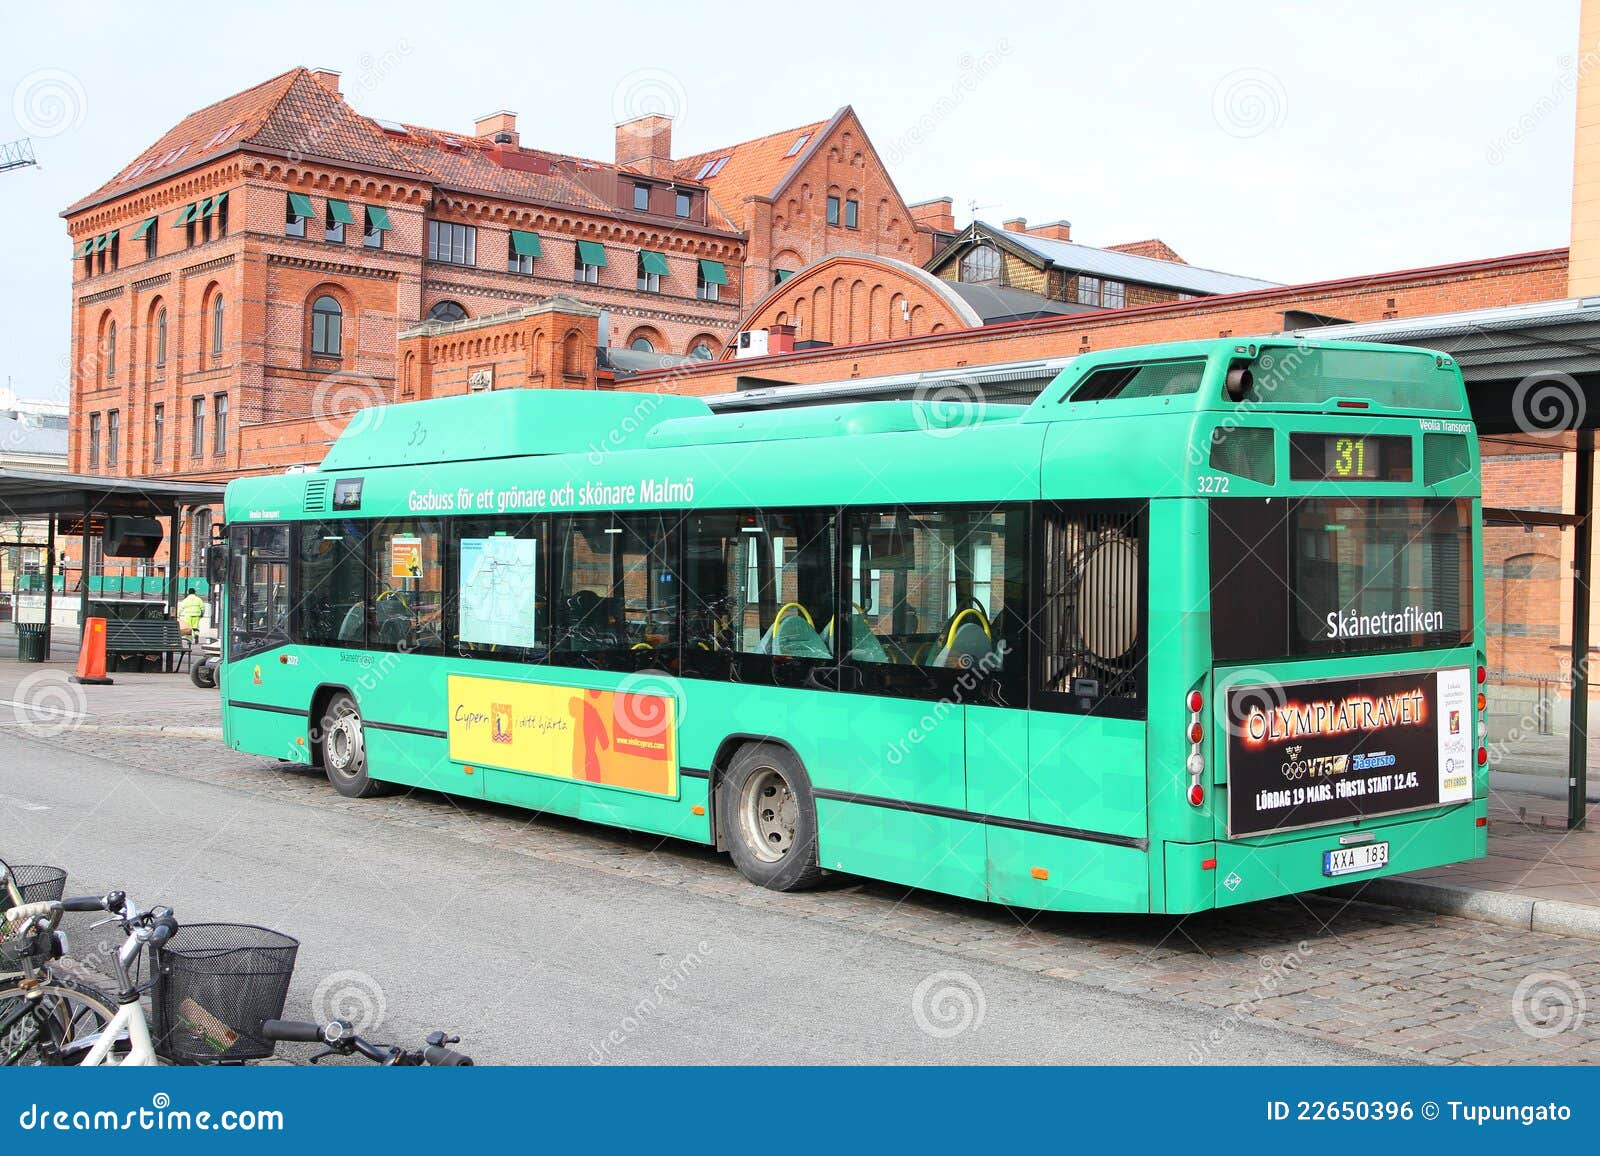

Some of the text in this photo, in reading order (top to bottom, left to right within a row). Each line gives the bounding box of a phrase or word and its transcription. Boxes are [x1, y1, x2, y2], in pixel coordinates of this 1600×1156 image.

[1419, 419, 1471, 434] Veolia Transport
[1336, 438, 1364, 476] 31
[408, 476, 694, 513] Gasbuss för ett grönare och skönare Malmö
[1198, 476, 1229, 494] 3272
[1326, 605, 1443, 639] Skånetrafiken
[455, 704, 489, 732] Cypern
[1249, 696, 1424, 740] OLYMPIATRAVET
[1255, 772, 1419, 811] LÖRDAG 19 MARS. FÖRSTA START 12.45.
[1332, 845, 1386, 870] XXA 183
